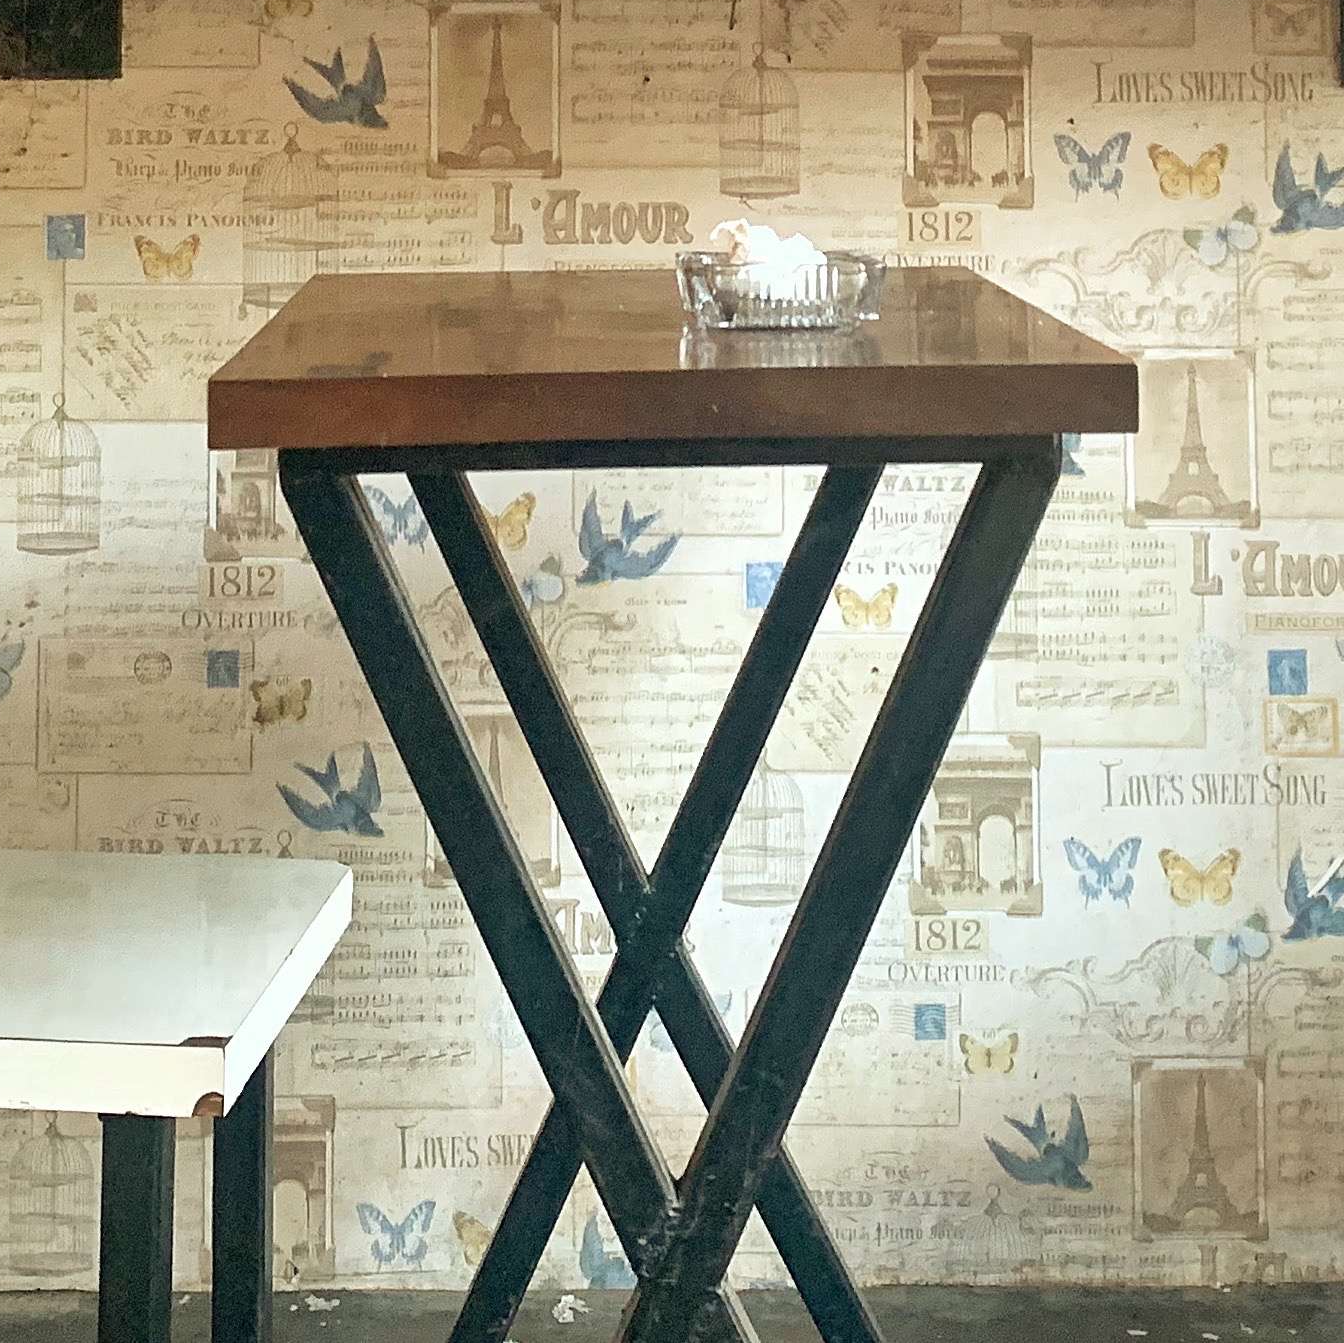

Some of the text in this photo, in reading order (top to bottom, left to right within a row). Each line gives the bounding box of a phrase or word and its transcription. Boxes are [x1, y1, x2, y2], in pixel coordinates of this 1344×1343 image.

[106, 128, 173, 145] BIRD
[97, 213, 276, 227] FRANCIS PANORMO
[908, 211, 974, 242] 1812
[208, 564, 276, 598] 1812
[181, 609, 298, 629] OVERTURE
[1191, 772, 1259, 806] SWEET
[1262, 761, 1327, 807] SONG
[97, 837, 165, 854] BIRD
[914, 919, 982, 952] 1812
[887, 961, 1006, 983] OVERTURE
[487, 1133, 538, 1167] SWE
